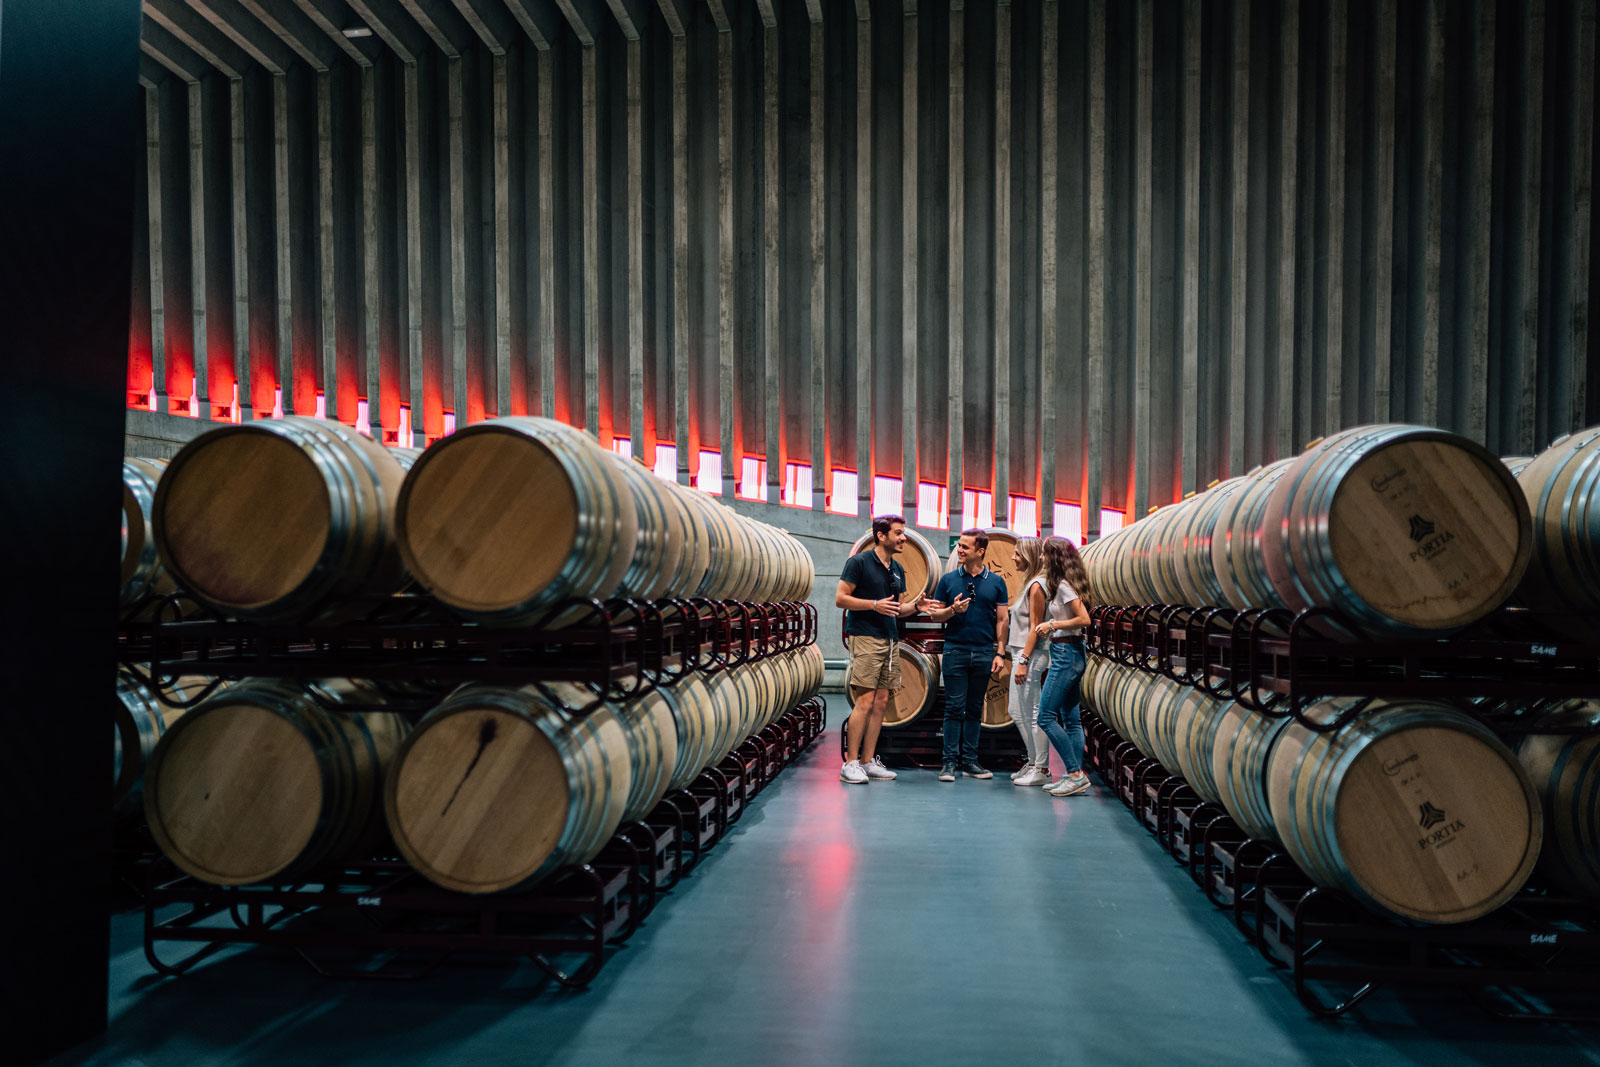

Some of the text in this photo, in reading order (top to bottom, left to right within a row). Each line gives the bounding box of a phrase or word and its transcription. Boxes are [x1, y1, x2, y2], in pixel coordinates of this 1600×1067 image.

[1410, 531, 1455, 562] PORTIA
[1531, 645, 1557, 656] SAME
[1418, 820, 1466, 849] PORTIA
[1530, 934, 1557, 944] SAME
